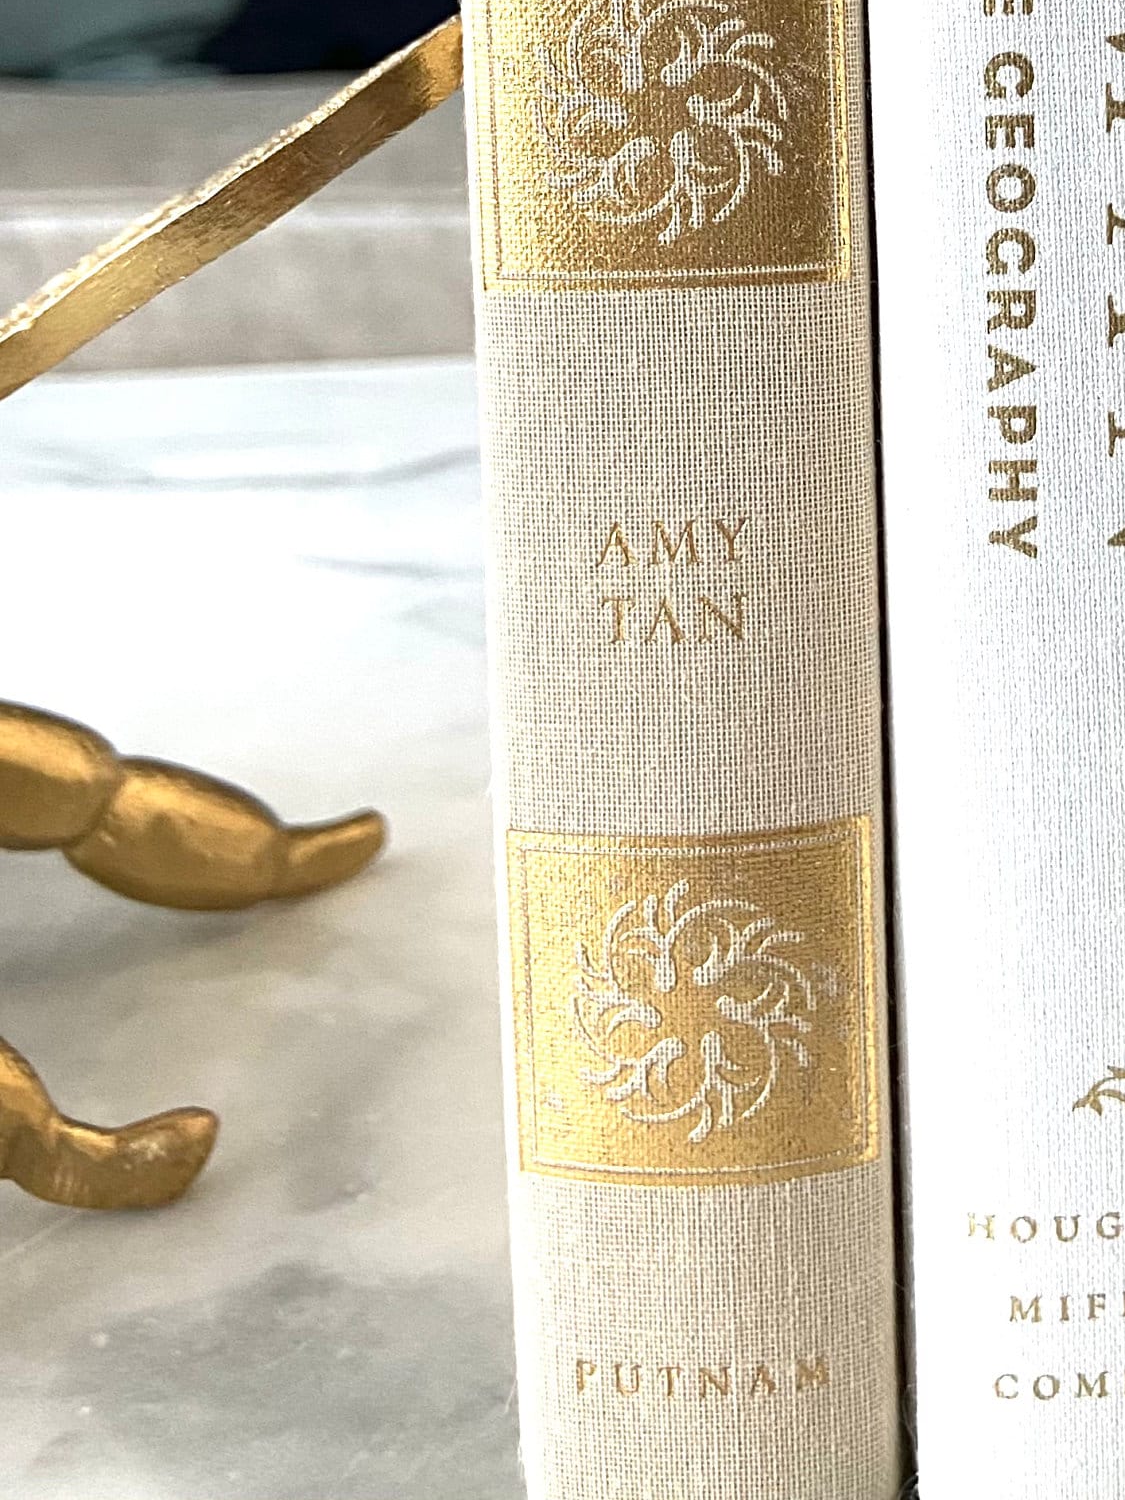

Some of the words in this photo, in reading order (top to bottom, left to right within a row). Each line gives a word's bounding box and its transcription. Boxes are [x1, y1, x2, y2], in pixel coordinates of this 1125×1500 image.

[983, 50, 1038, 558] GEOGRAPHY
[596, 517, 750, 567] AMY
[601, 592, 748, 644] TAN
[576, 1355, 829, 1399] PUTNAM
